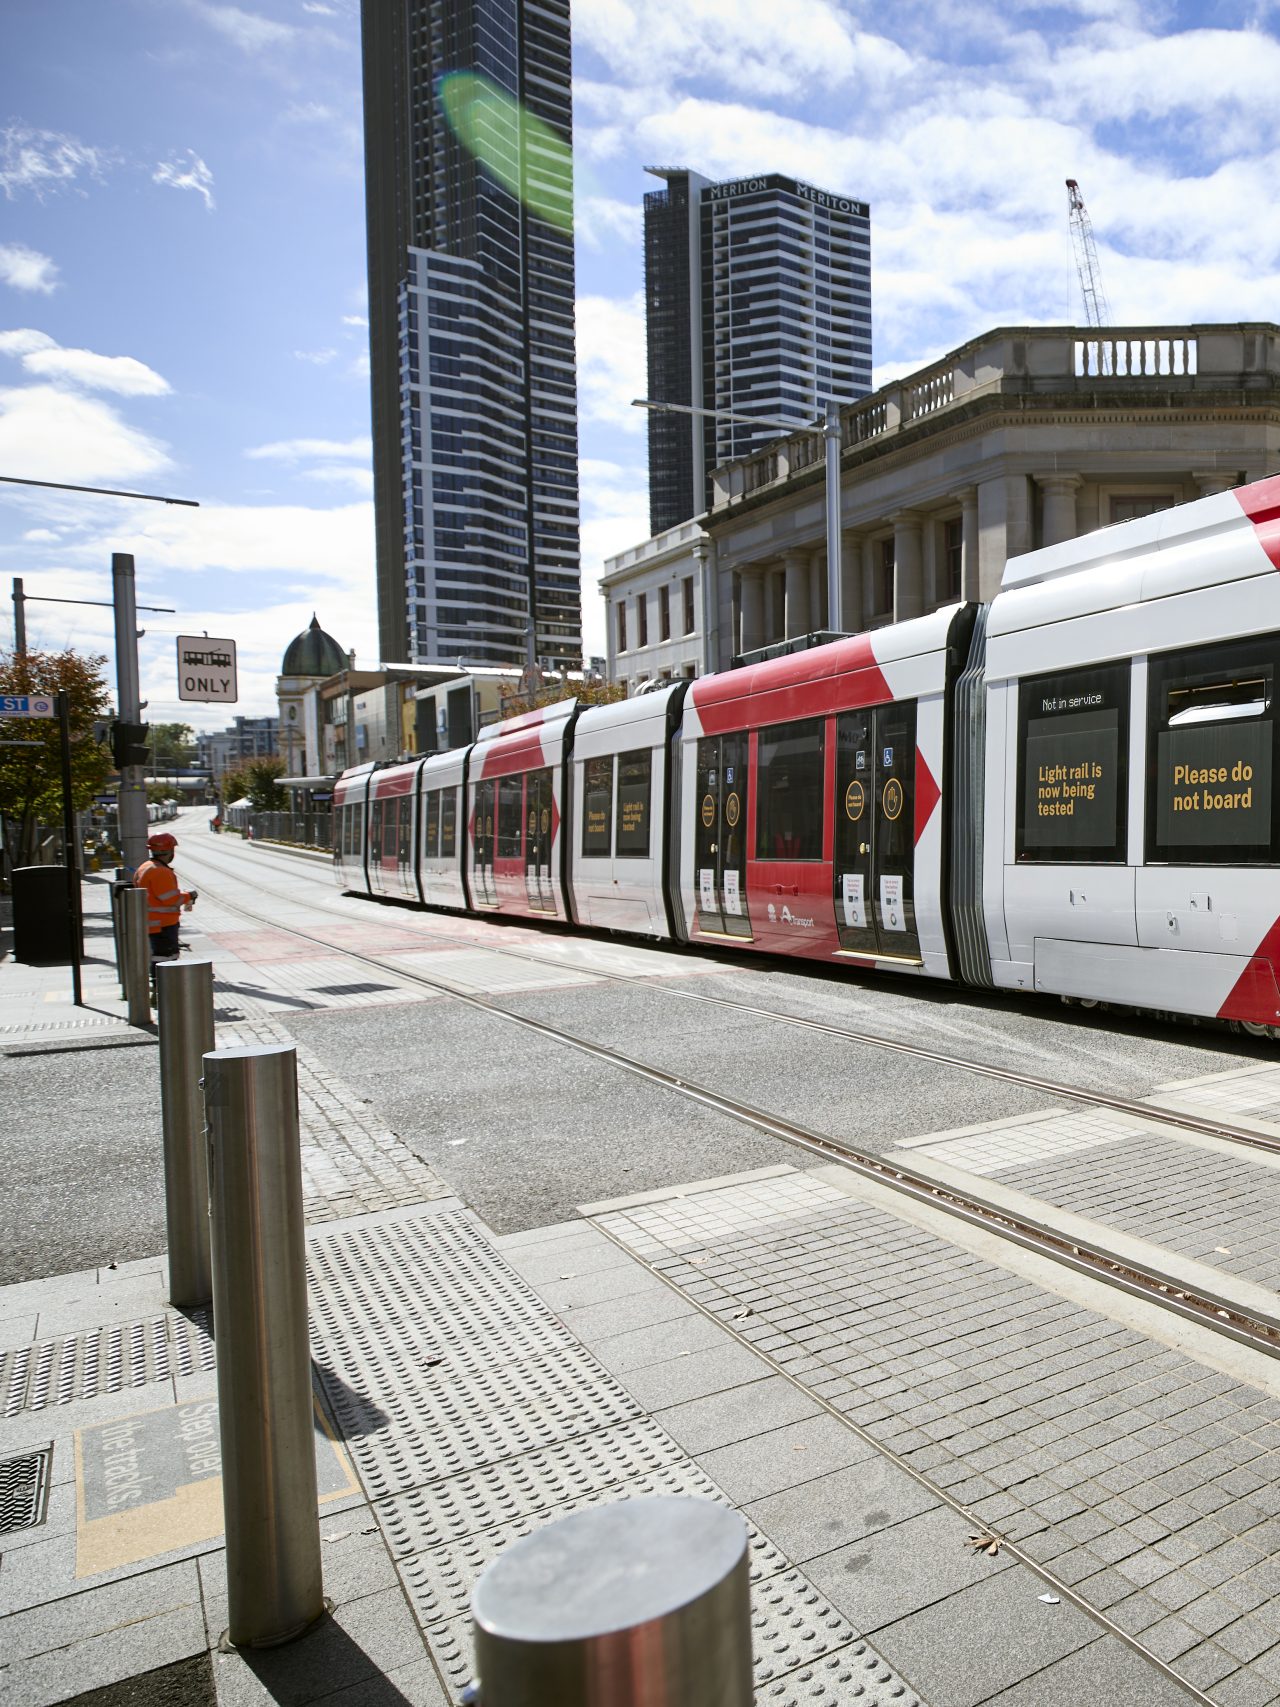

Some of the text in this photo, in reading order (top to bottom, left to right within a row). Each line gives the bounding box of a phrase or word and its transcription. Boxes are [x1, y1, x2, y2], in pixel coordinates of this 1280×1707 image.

[710, 178, 767, 200] MERITON
[796, 182, 861, 215] MERITON
[185, 676, 230, 694] ONLY
[3, 698, 25, 710] ST
[1042, 693, 1102, 711] Not in service
[1039, 762, 1102, 784] Light rail is
[1174, 760, 1253, 785] Please do
[1038, 781, 1095, 800] now being
[1173, 787, 1252, 811] not board
[1038, 799, 1074, 816] tested
[102, 1420, 145, 1451] the
[173, 1402, 222, 1476] Step over
